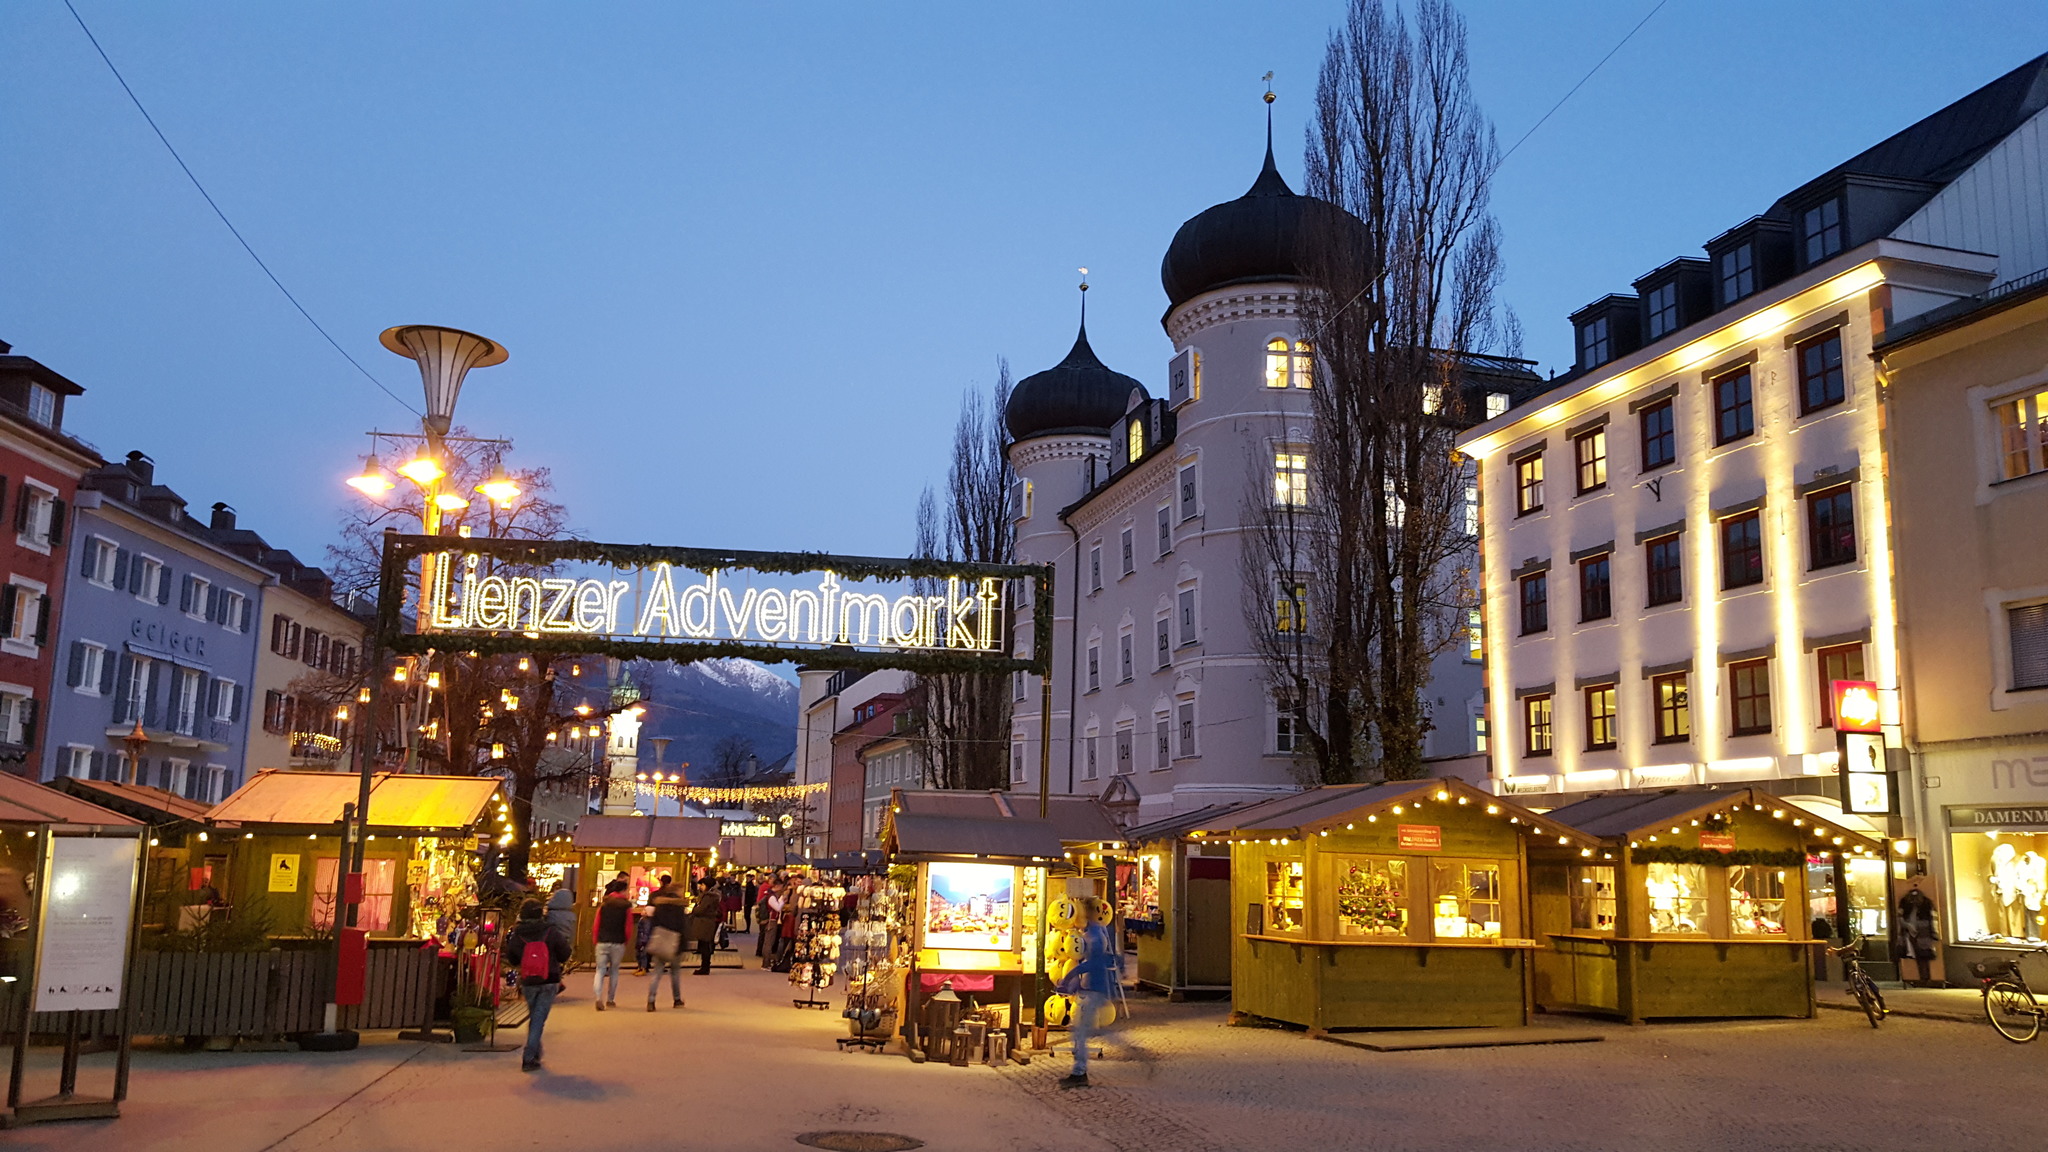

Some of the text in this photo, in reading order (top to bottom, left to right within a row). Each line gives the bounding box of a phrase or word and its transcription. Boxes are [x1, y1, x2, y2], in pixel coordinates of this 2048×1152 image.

[1174, 369, 1184, 390] 12
[1153, 415, 1159, 432] 5
[1184, 482, 1194, 502] 20
[1161, 523, 1168, 540] 11
[1124, 544, 1132, 560] 21
[431, 549, 999, 651] Lienzer Adventmarkt
[1185, 608, 1190, 625] 1
[1159, 633, 1168, 650] 23
[1125, 648, 1130, 664] 2
[1090, 660, 1098, 676] 22
[1182, 721, 1191, 740] 17
[1120, 745, 1129, 760] 24
[1159, 737, 1168, 753] 14
[1014, 756, 1021, 770] 10
[1090, 751, 1095, 765] 8
